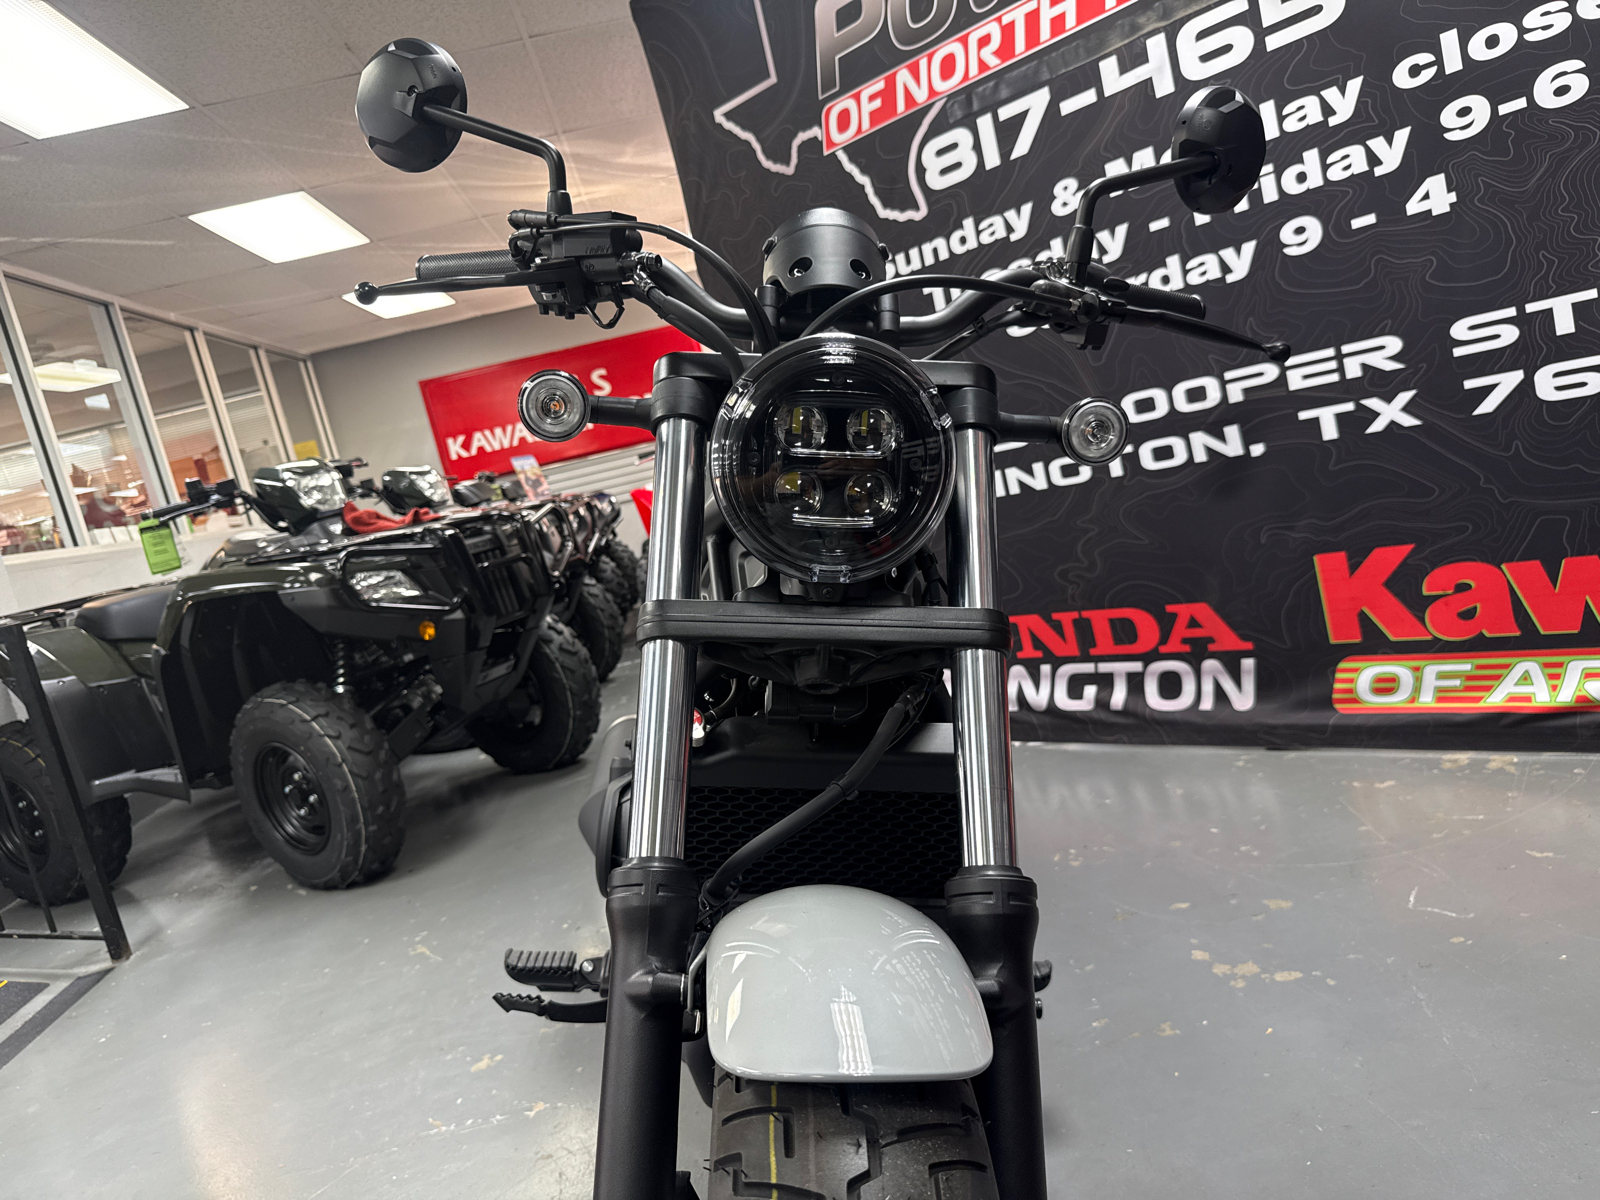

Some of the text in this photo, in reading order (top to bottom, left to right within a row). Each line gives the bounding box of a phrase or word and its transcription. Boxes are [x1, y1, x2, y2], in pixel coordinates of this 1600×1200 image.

[828, 0, 1077, 144] OF NORTH
[1439, 59, 1590, 141] 9-6
[1279, 215, 1323, 256] 9
[1405, 172, 1457, 217] 4
[1120, 288, 1599, 424] OOPER ST
[1297, 389, 1424, 442] TX
[1009, 602, 1255, 659] NDA
[1006, 657, 1258, 713] NGTON
[1355, 662, 1474, 704] OF
